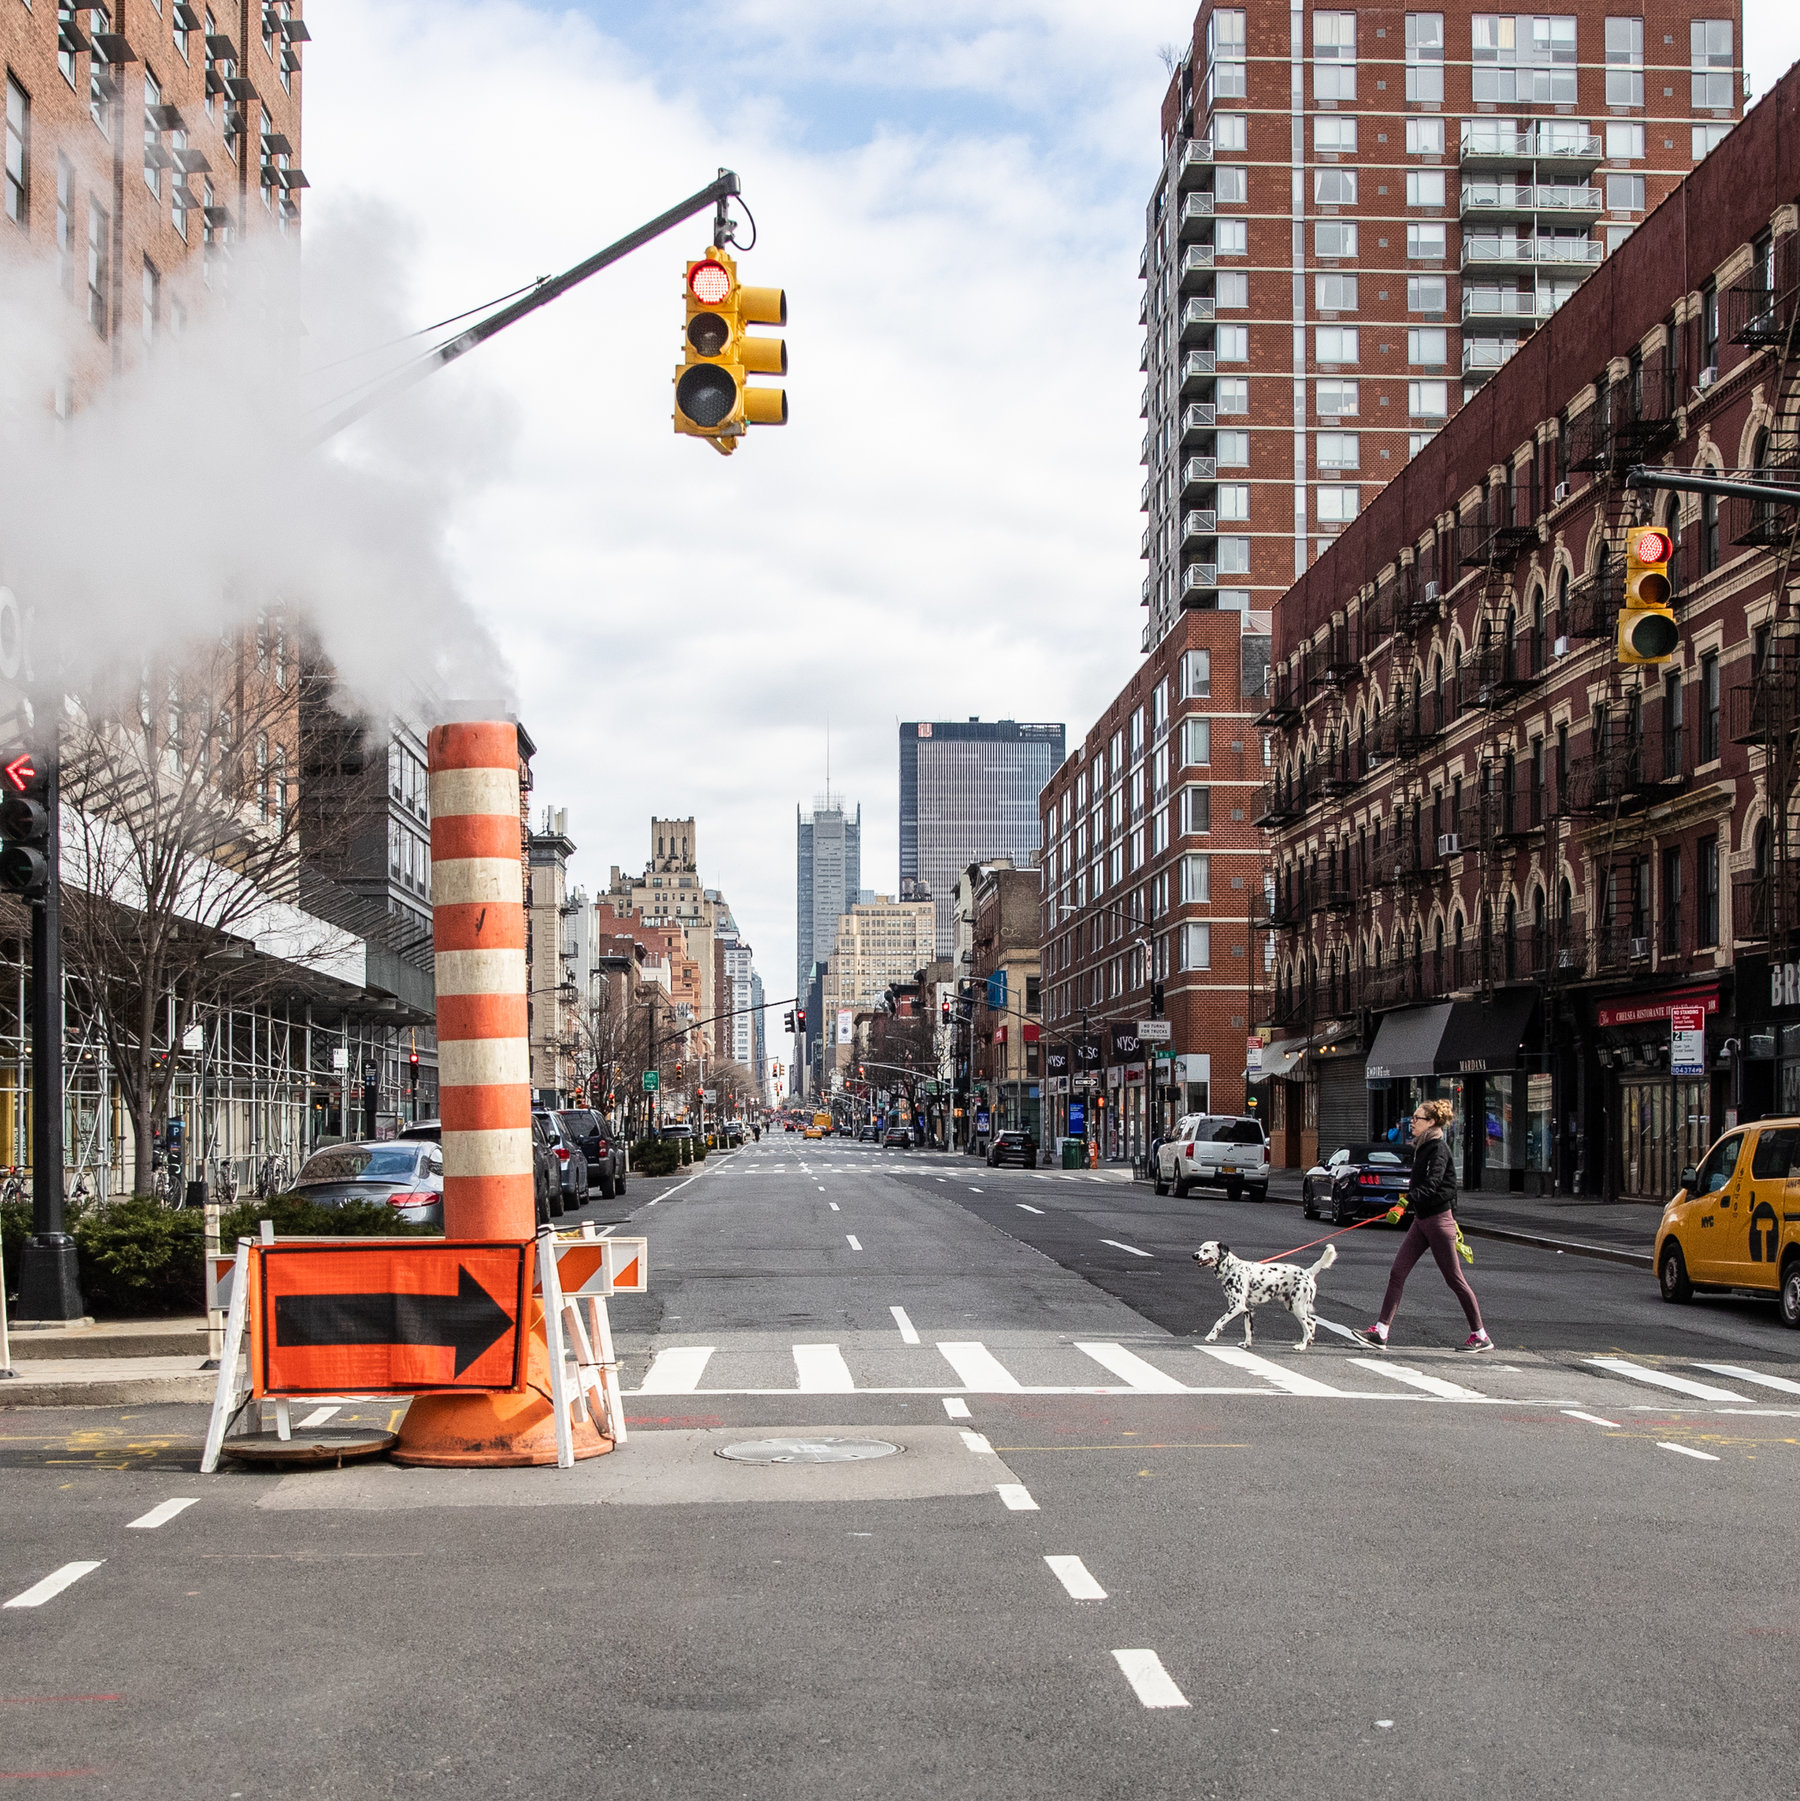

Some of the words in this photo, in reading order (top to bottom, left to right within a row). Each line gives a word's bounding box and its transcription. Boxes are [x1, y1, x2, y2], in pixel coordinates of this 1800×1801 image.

[1771, 959, 1800, 1006] BR
[1616, 1010, 1635, 1021] CHELSEA
[1637, 1006, 1665, 1019] RISTORANTE
[1674, 1032, 1680, 1041] 2
[1117, 1036, 1140, 1051] NYSC
[1078, 1047, 1098, 1059] NSC
[1366, 1066, 1383, 1077] EMPIRE
[1673, 1127, 1679, 1136] P
[1701, 1215, 1715, 1228] NYC
